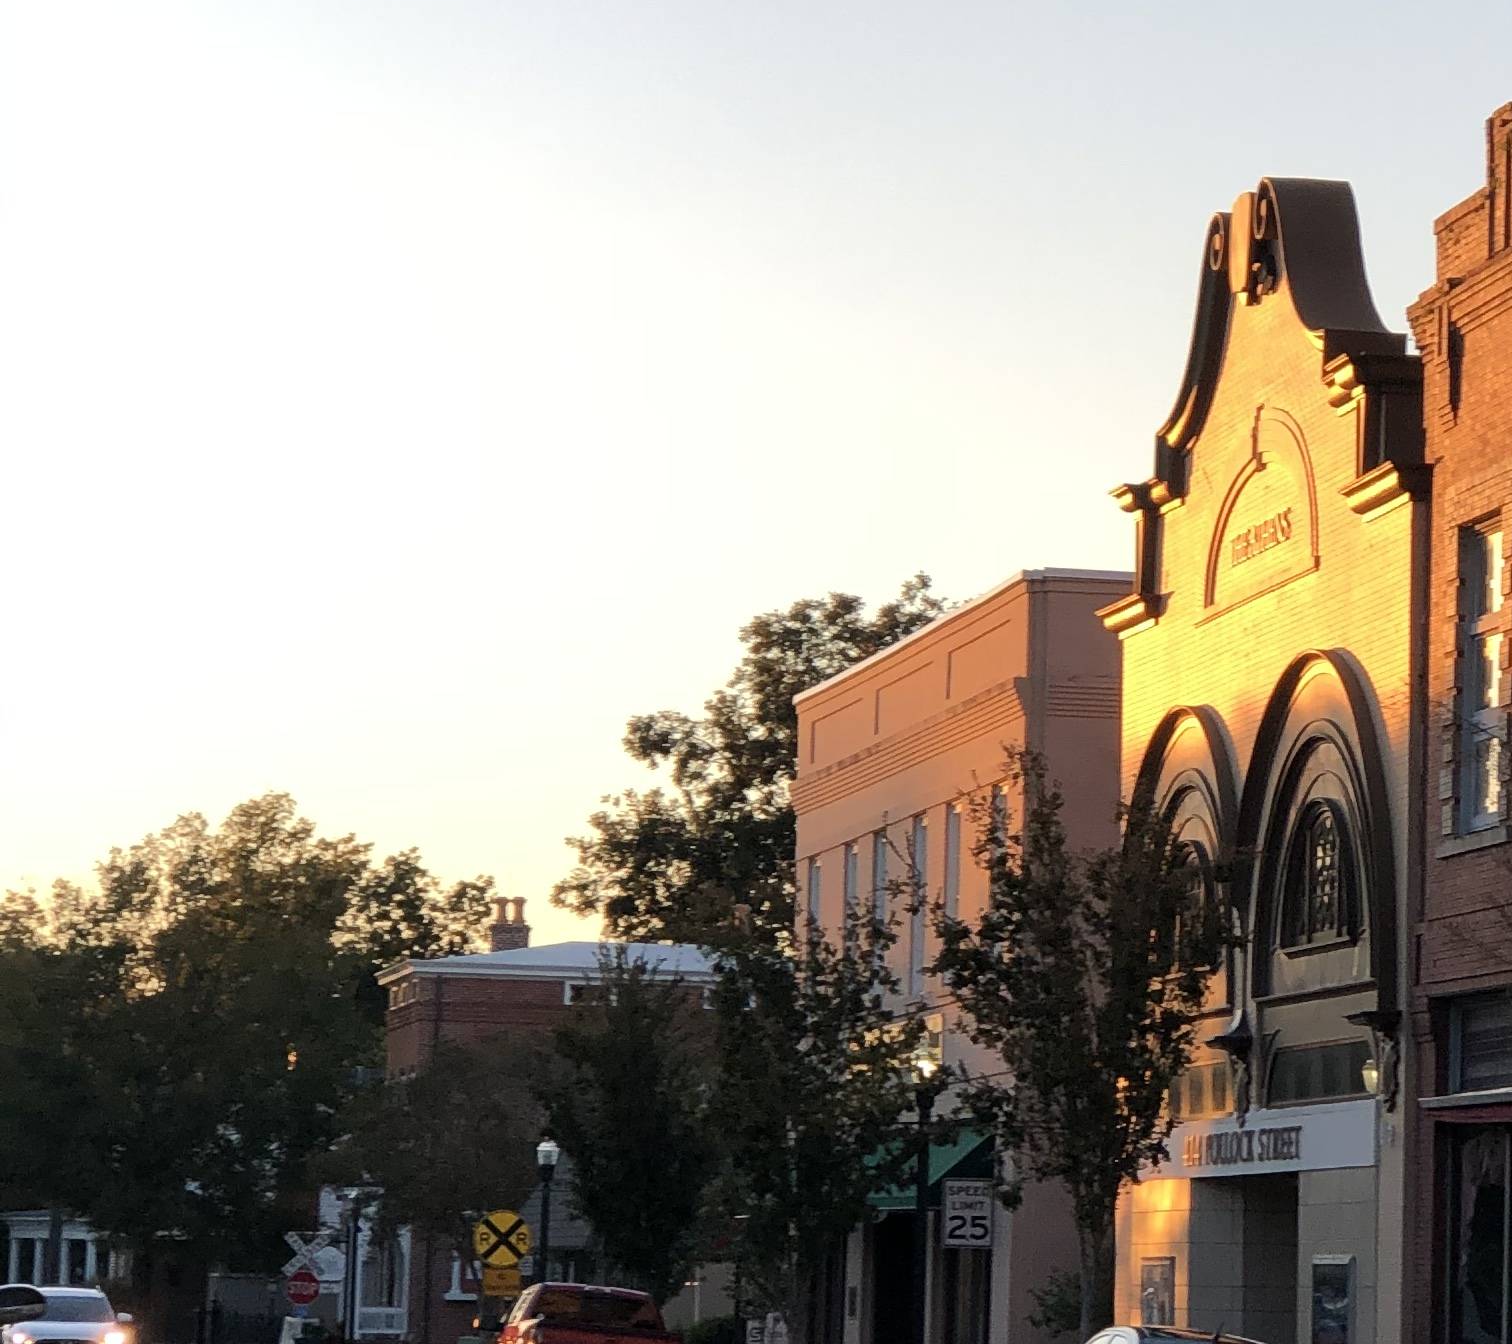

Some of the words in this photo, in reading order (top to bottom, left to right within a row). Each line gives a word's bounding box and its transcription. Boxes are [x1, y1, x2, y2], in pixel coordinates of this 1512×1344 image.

[1257, 1125, 1302, 1162] STREET
[951, 1201, 986, 1212] LIMIT
[948, 1215, 989, 1241] 25
[479, 1232, 491, 1245] R
[516, 1232, 528, 1245] R
[287, 1282, 318, 1294] STOP
